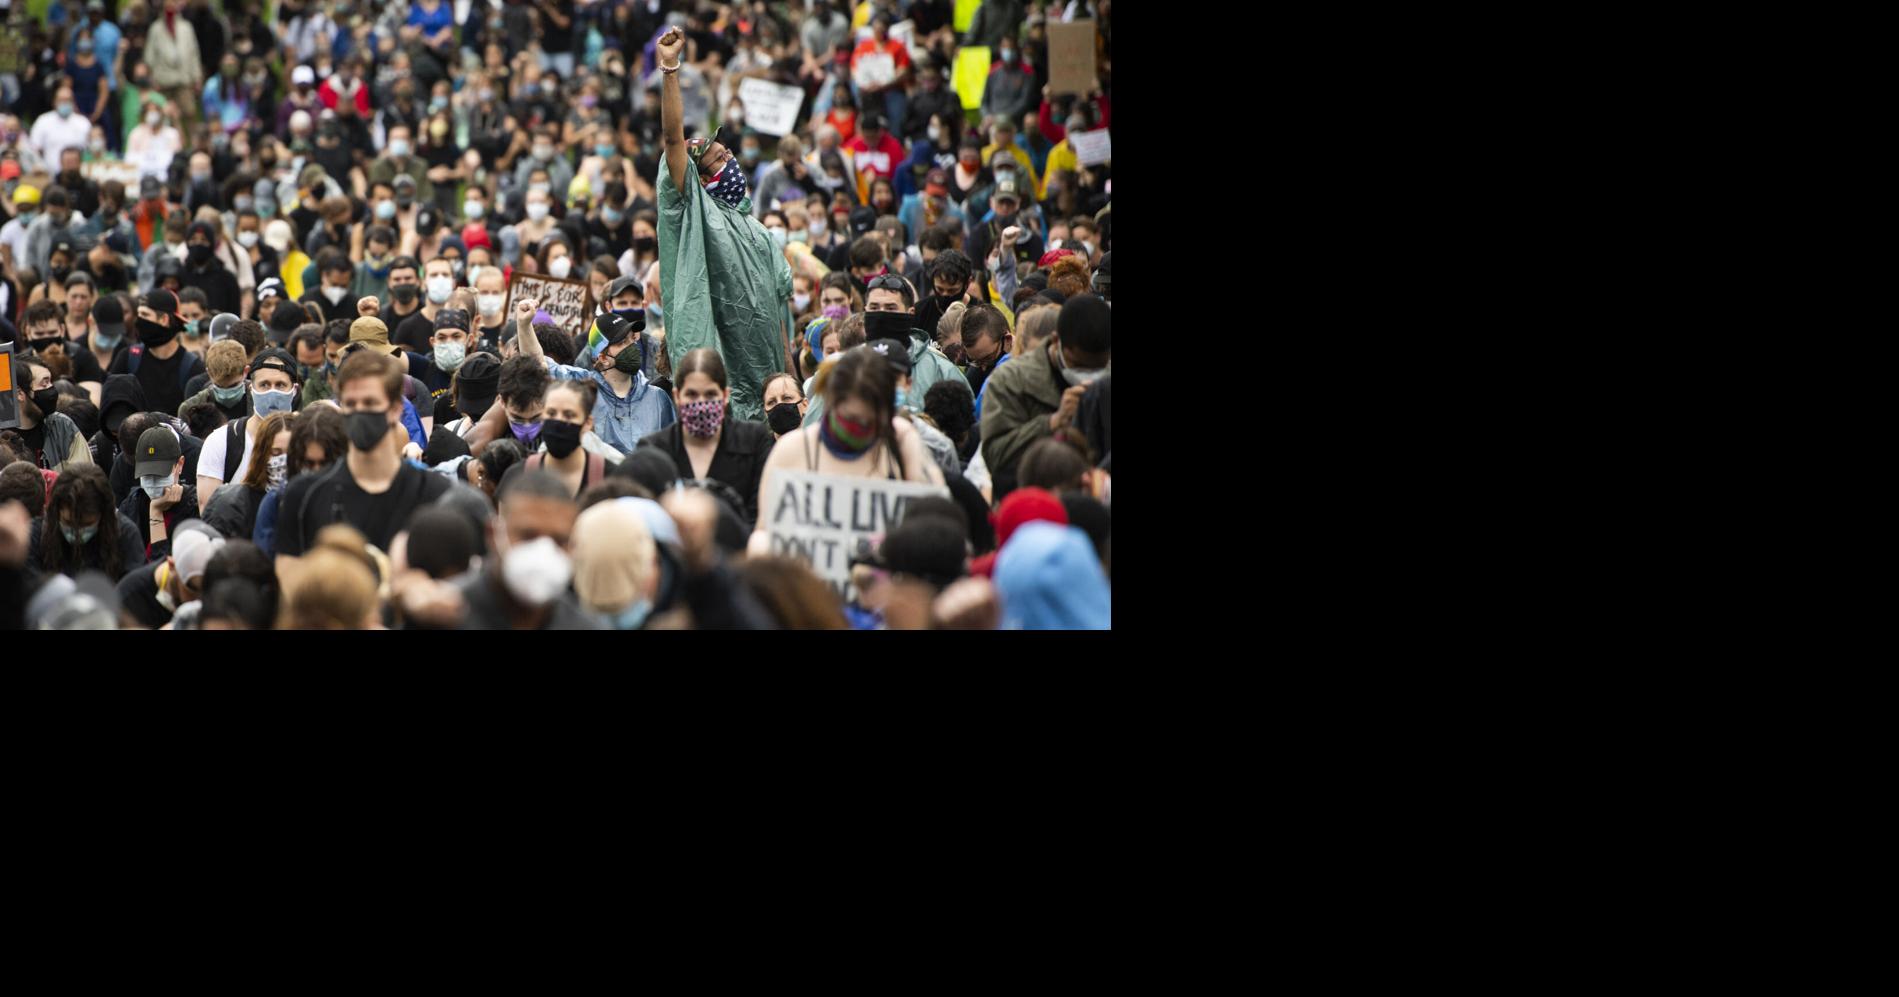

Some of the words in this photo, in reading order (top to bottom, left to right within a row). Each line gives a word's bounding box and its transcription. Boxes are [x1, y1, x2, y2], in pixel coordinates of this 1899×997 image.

[515, 280, 540, 298] THIS
[773, 482, 842, 529] ALL
[851, 489, 905, 532] LIV
